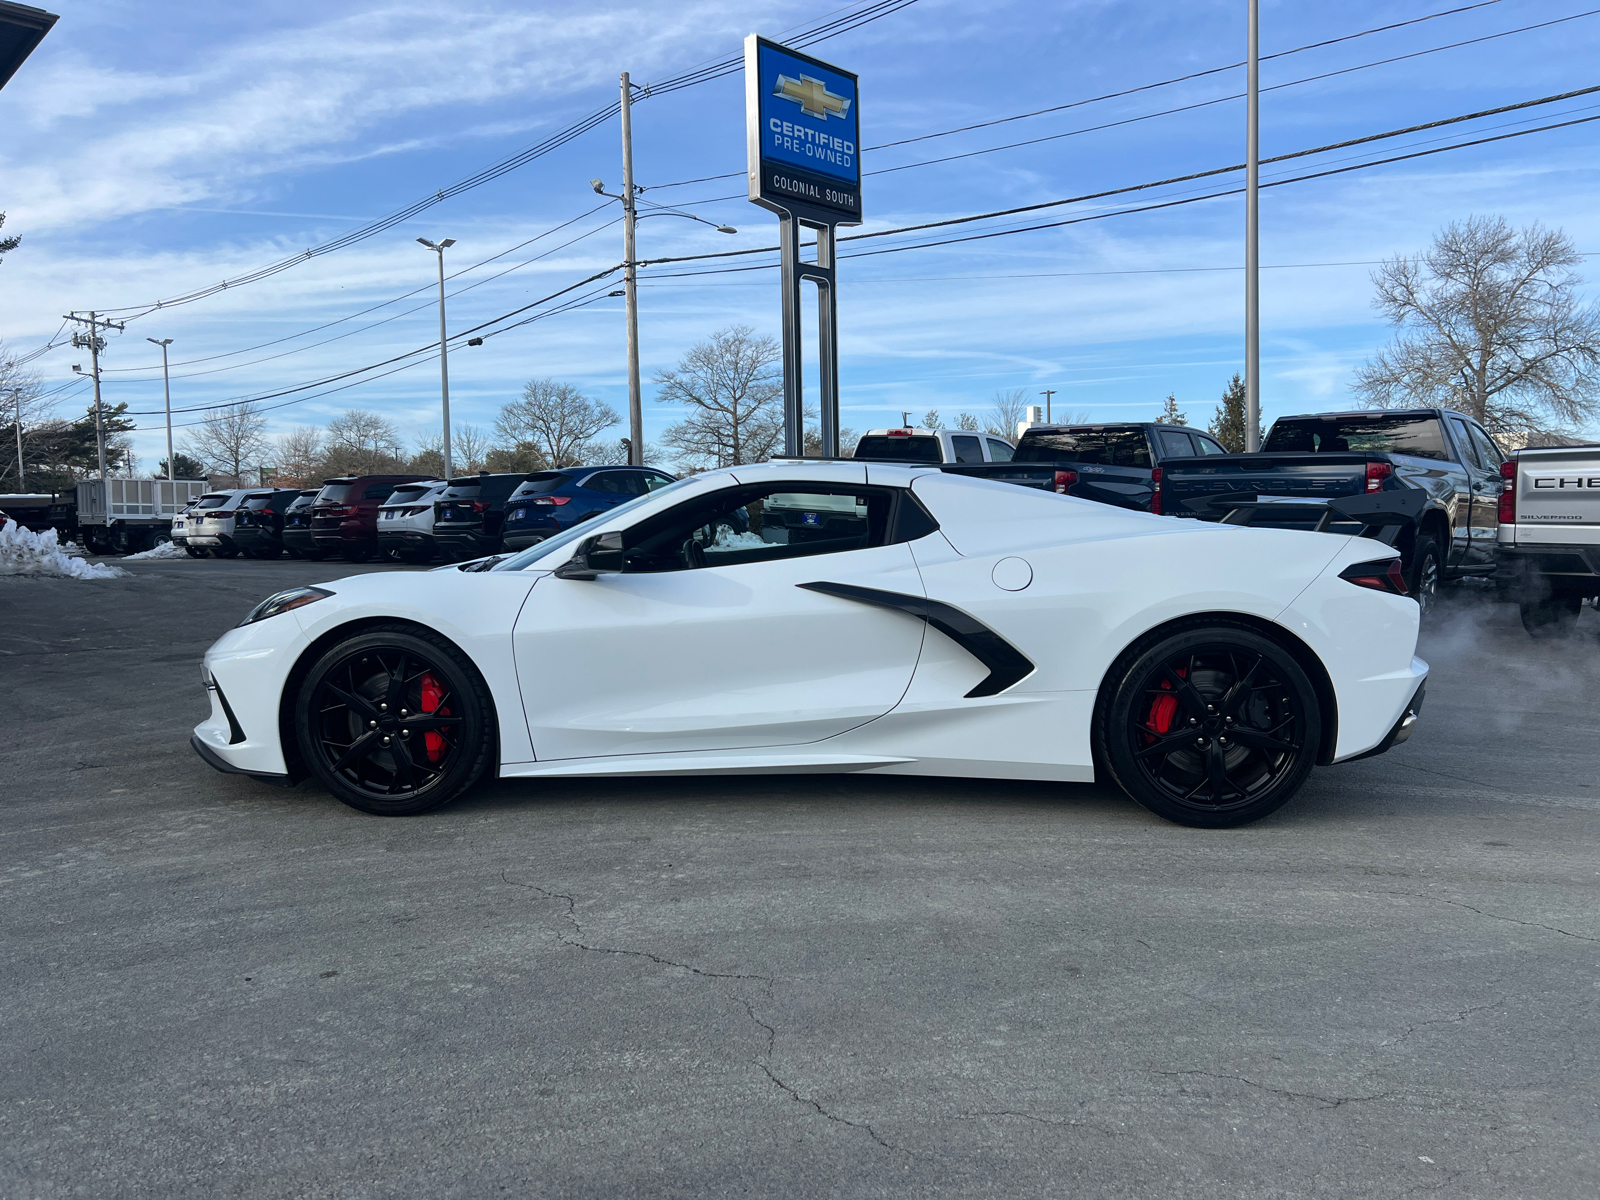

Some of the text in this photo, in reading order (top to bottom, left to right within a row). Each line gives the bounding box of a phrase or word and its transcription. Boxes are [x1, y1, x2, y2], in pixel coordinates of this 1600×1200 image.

[769, 117, 854, 155] CERTIFIED
[774, 134, 851, 168] PRE-OWNED
[773, 174, 854, 207] COLONIAL SOUTH
[1172, 478, 1349, 492] CHEVROLET
